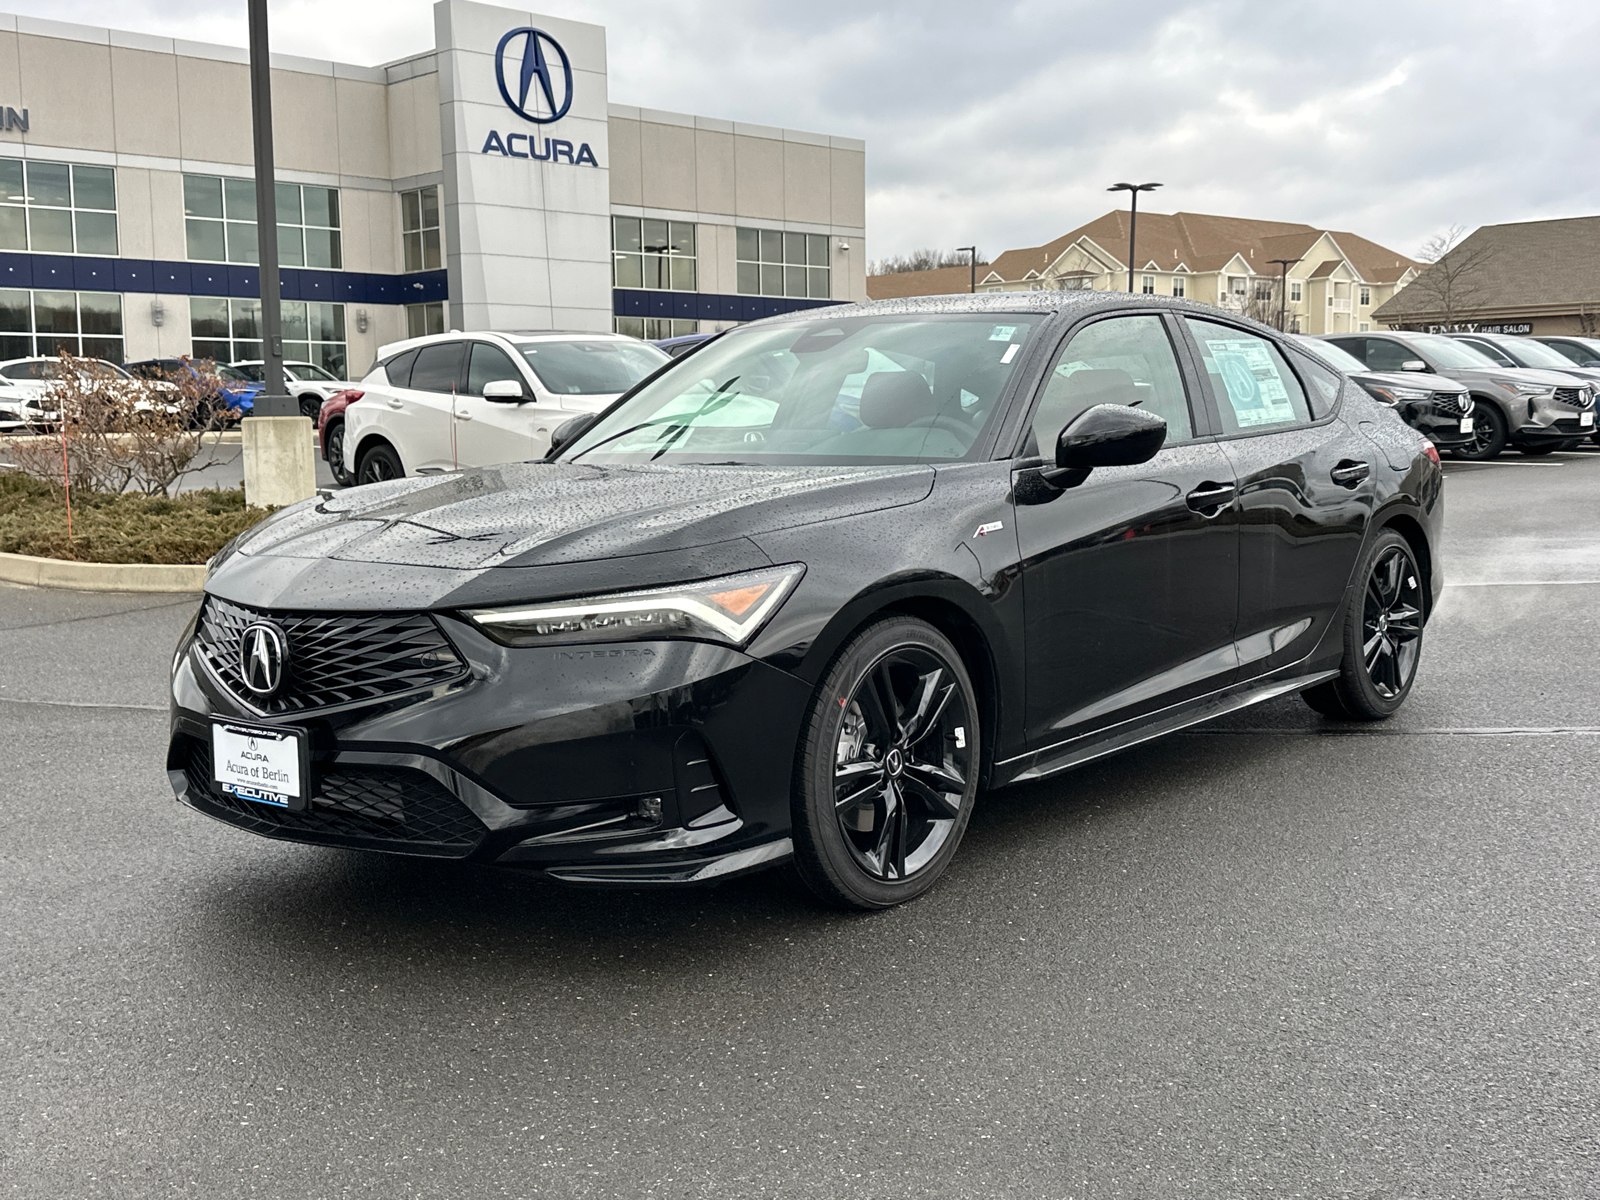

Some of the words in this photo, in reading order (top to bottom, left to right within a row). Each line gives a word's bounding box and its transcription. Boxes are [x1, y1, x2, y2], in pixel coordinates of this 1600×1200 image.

[481, 129, 599, 168] ACURA
[1481, 325, 1501, 334] HAIR
[1503, 324, 1530, 334] SALON
[553, 648, 656, 661] INTEGRA
[240, 751, 269, 762] ACURA
[226, 759, 249, 776] Acura
[250, 766, 260, 778] of
[261, 766, 290, 783] Berlin
[222, 783, 288, 804] EXECUTIVE
